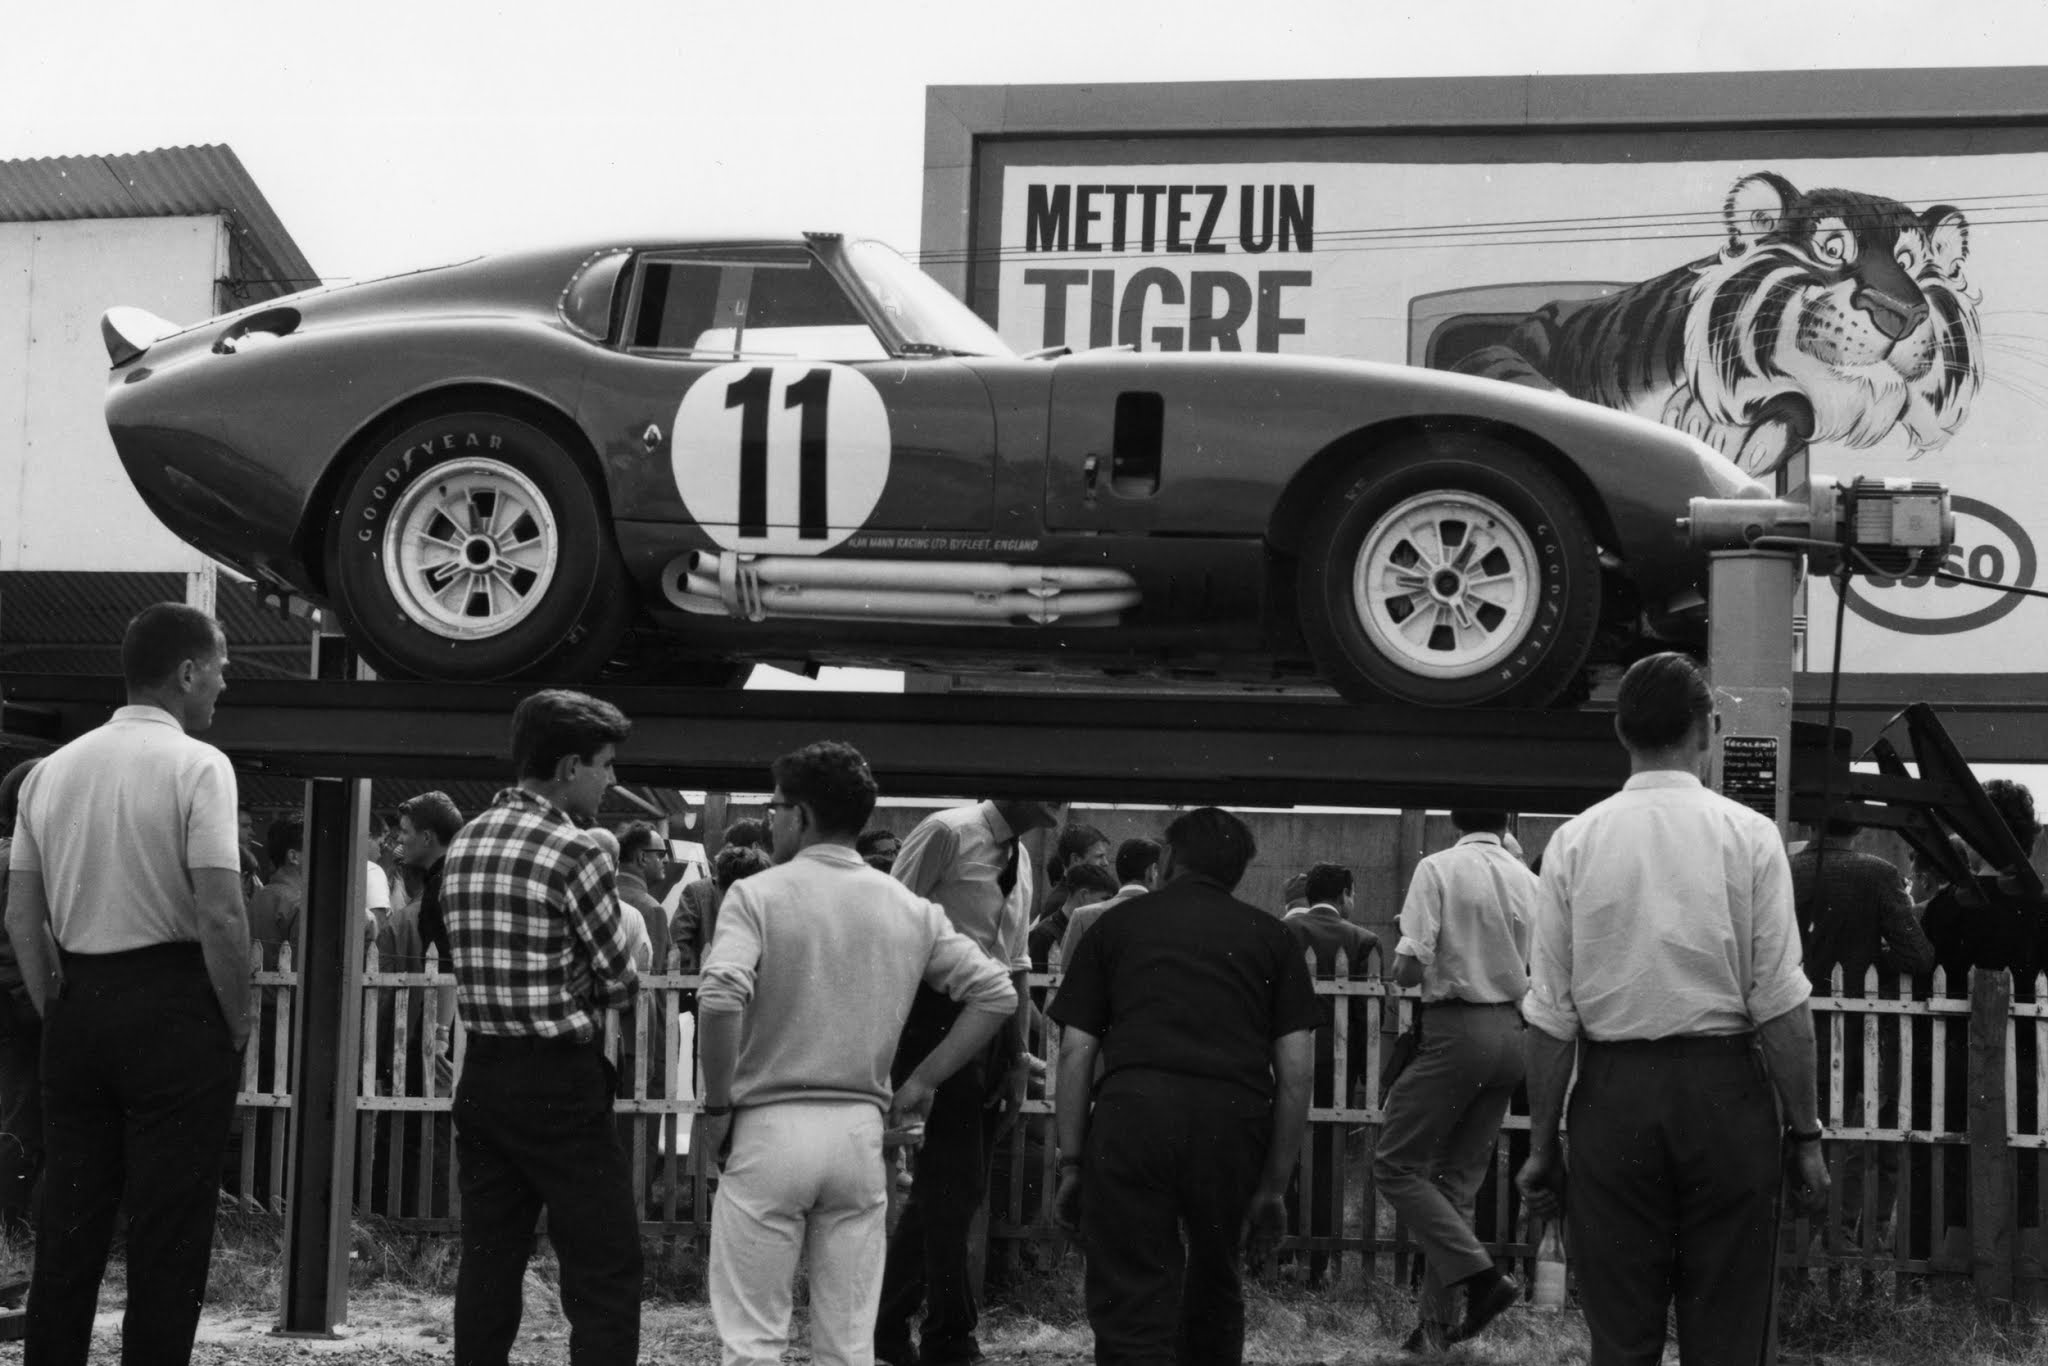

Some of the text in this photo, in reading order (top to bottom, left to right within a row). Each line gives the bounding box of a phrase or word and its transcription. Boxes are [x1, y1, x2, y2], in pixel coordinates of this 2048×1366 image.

[1025, 184, 1315, 254] METTEZ UN
[358, 432, 502, 542] GOODYEAR
[724, 367, 832, 540] 11
[869, 537, 895, 549] MANN
[896, 537, 929, 550] RACING
[994, 539, 1039, 551] ENGLAND
[1500, 523, 1561, 681] GOODYEAR
